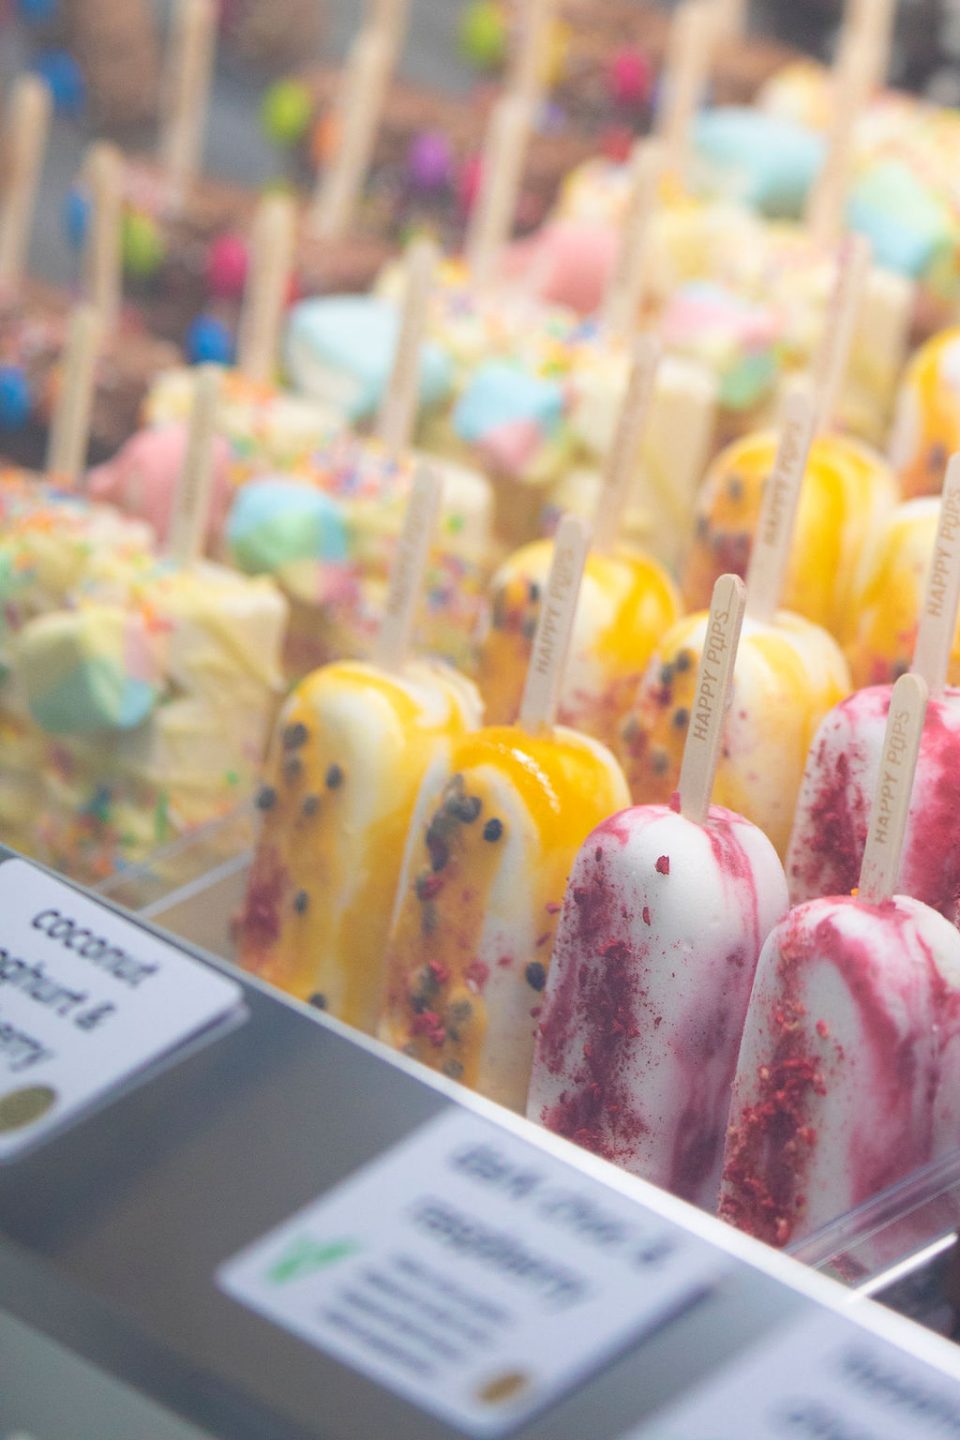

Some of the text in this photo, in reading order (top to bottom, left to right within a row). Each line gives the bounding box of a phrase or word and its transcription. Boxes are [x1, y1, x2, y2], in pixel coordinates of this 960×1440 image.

[927, 545, 956, 617] HAPPY
[536, 609, 563, 675] HAPPY
[693, 610, 729, 740] HAPPY POPS
[875, 710, 911, 843] HAPPY POPS
[32, 909, 161, 989] coconut
[72, 999, 117, 1033] &
